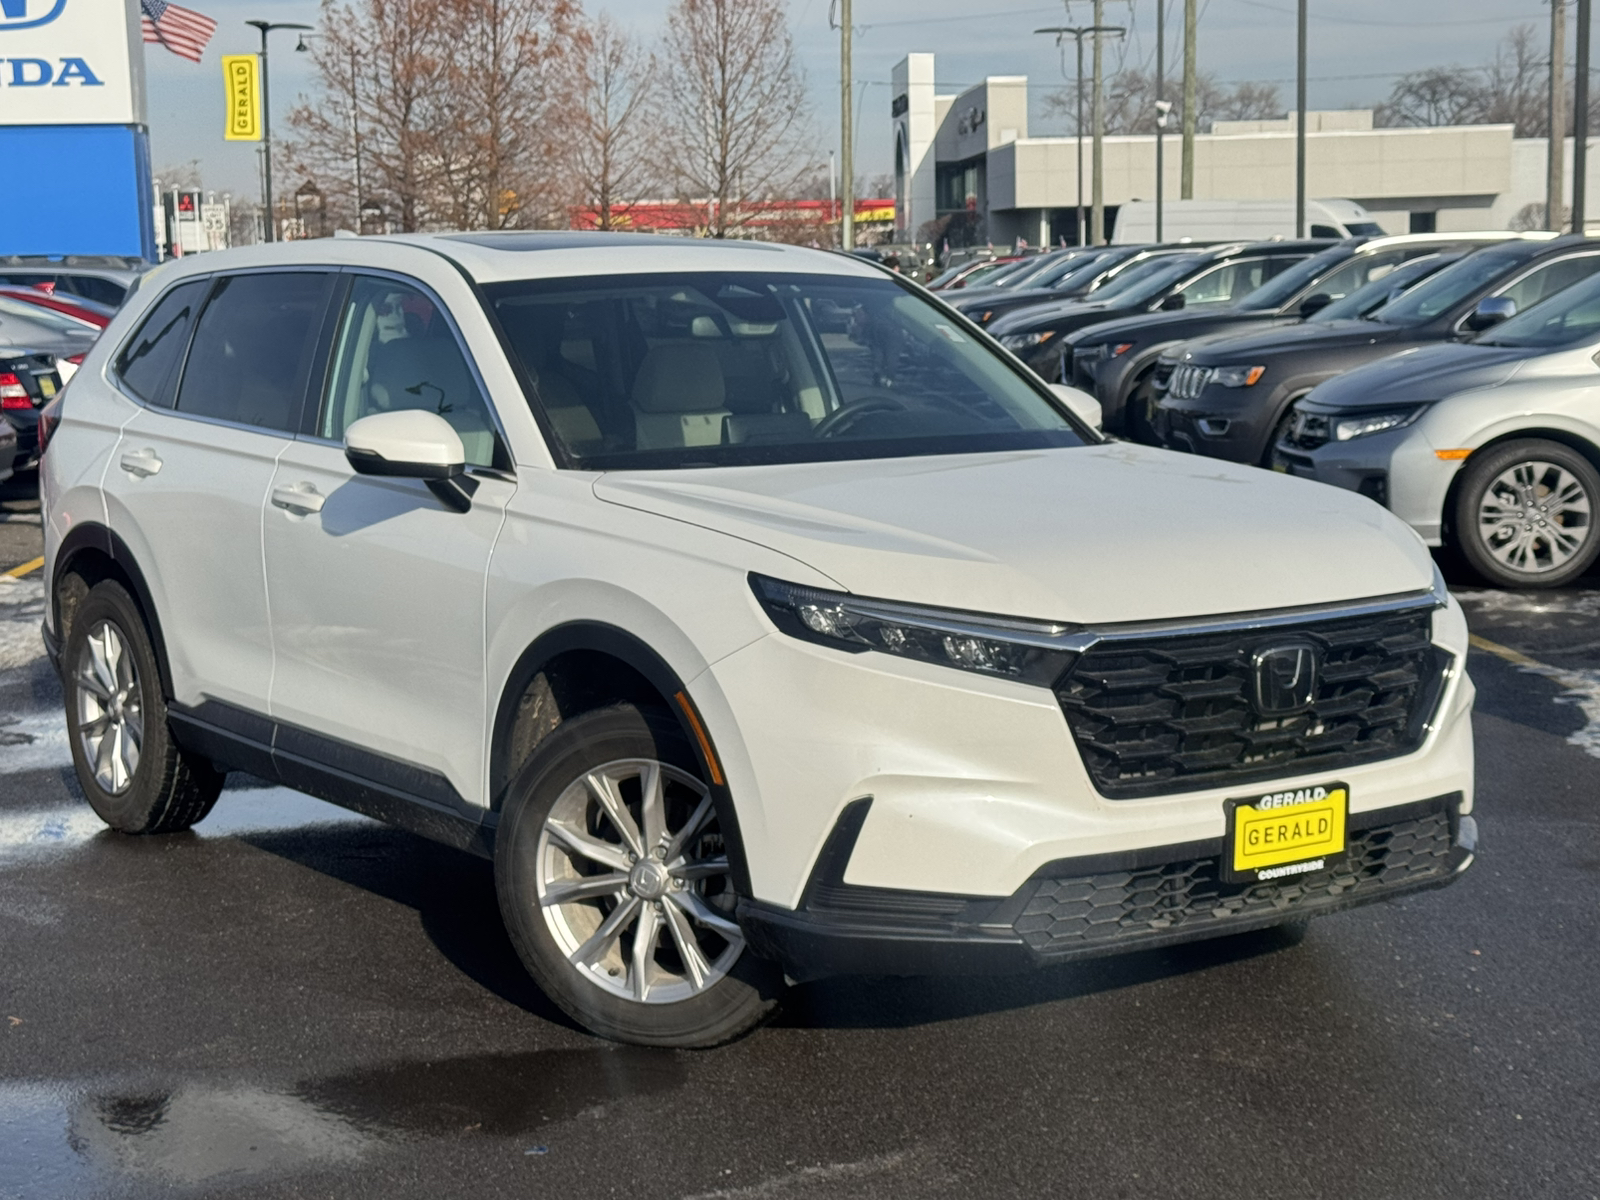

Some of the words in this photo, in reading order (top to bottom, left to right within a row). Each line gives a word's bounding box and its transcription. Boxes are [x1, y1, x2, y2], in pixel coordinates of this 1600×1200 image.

[0, 57, 105, 87] DA
[236, 66, 248, 129] GERALD
[1259, 787, 1326, 810] GERALD
[1249, 818, 1328, 845] GERALD
[1258, 859, 1324, 880] COUNTRYSIDE
